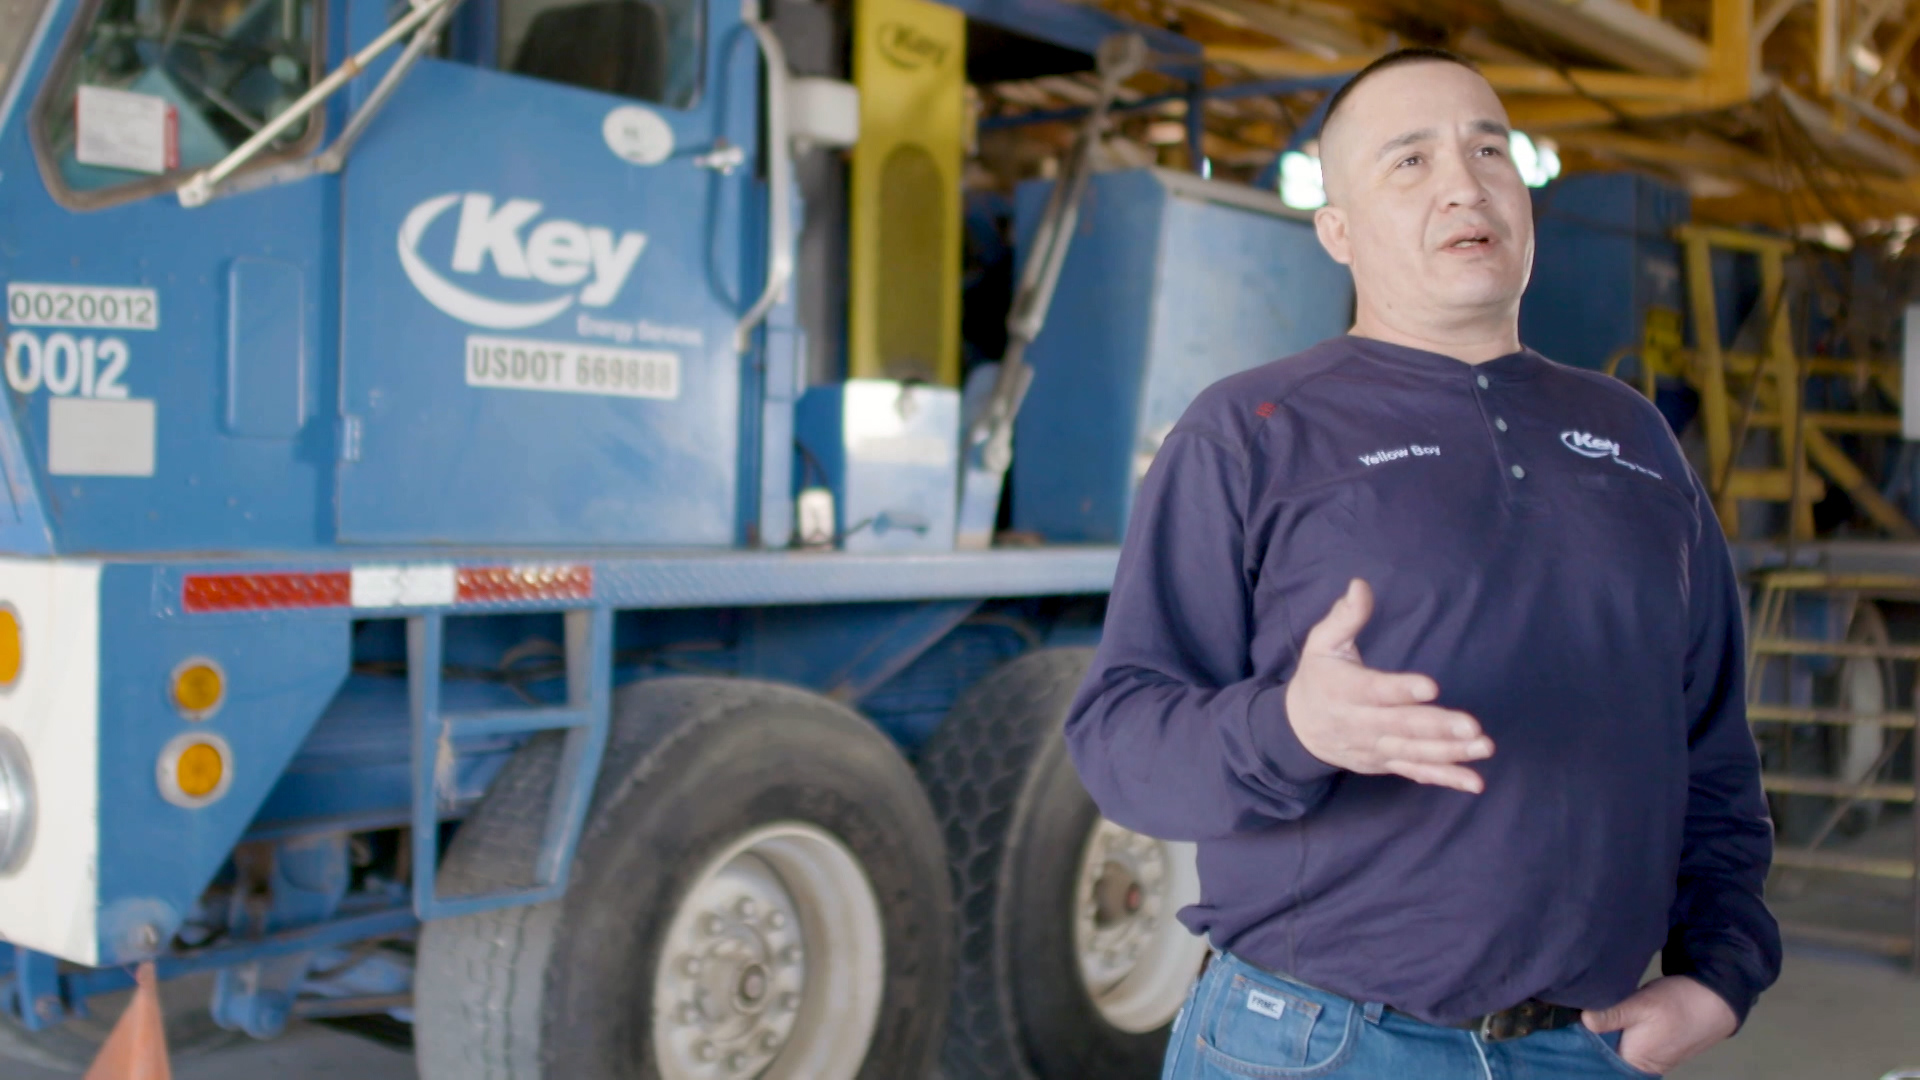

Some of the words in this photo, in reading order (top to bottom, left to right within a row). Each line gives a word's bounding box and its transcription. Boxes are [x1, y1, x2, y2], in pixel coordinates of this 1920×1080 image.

[451, 192, 649, 307] Key
[11, 291, 152, 322] 0020012
[5, 330, 129, 400] 0012
[472, 346, 565, 383] USDOT
[1358, 449, 1408, 466] Yellow
[1410, 445, 1441, 456] Boy
[1572, 431, 1620, 456] Key
